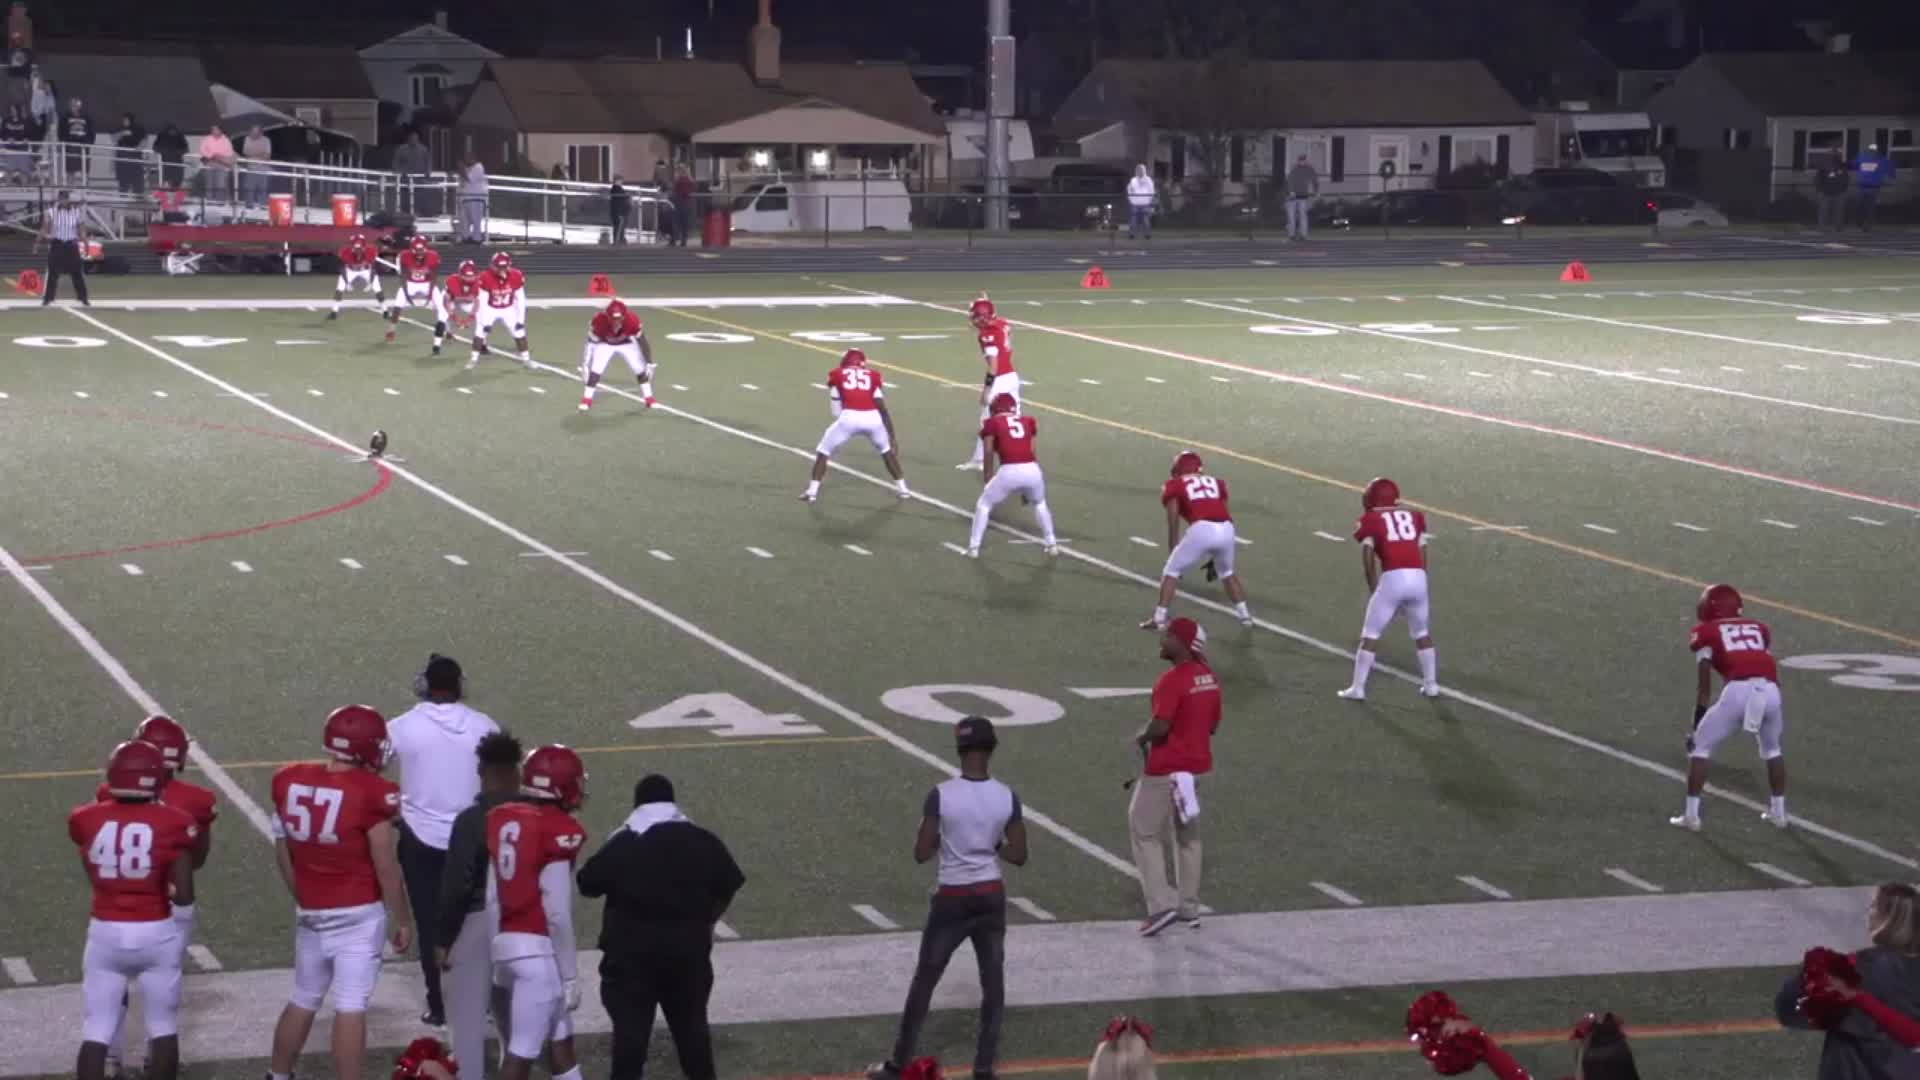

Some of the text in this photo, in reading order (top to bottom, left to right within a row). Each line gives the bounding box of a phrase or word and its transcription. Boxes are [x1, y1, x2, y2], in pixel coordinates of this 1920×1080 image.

[841, 367, 871, 390] 35
[1006, 415, 1025, 439] 5
[1183, 474, 1220, 500] 29
[1380, 509, 1417, 541] 18
[1719, 622, 1765, 651] 25
[284, 783, 344, 845] 57
[87, 820, 154, 880] 48
[497, 820, 519, 881] 6
